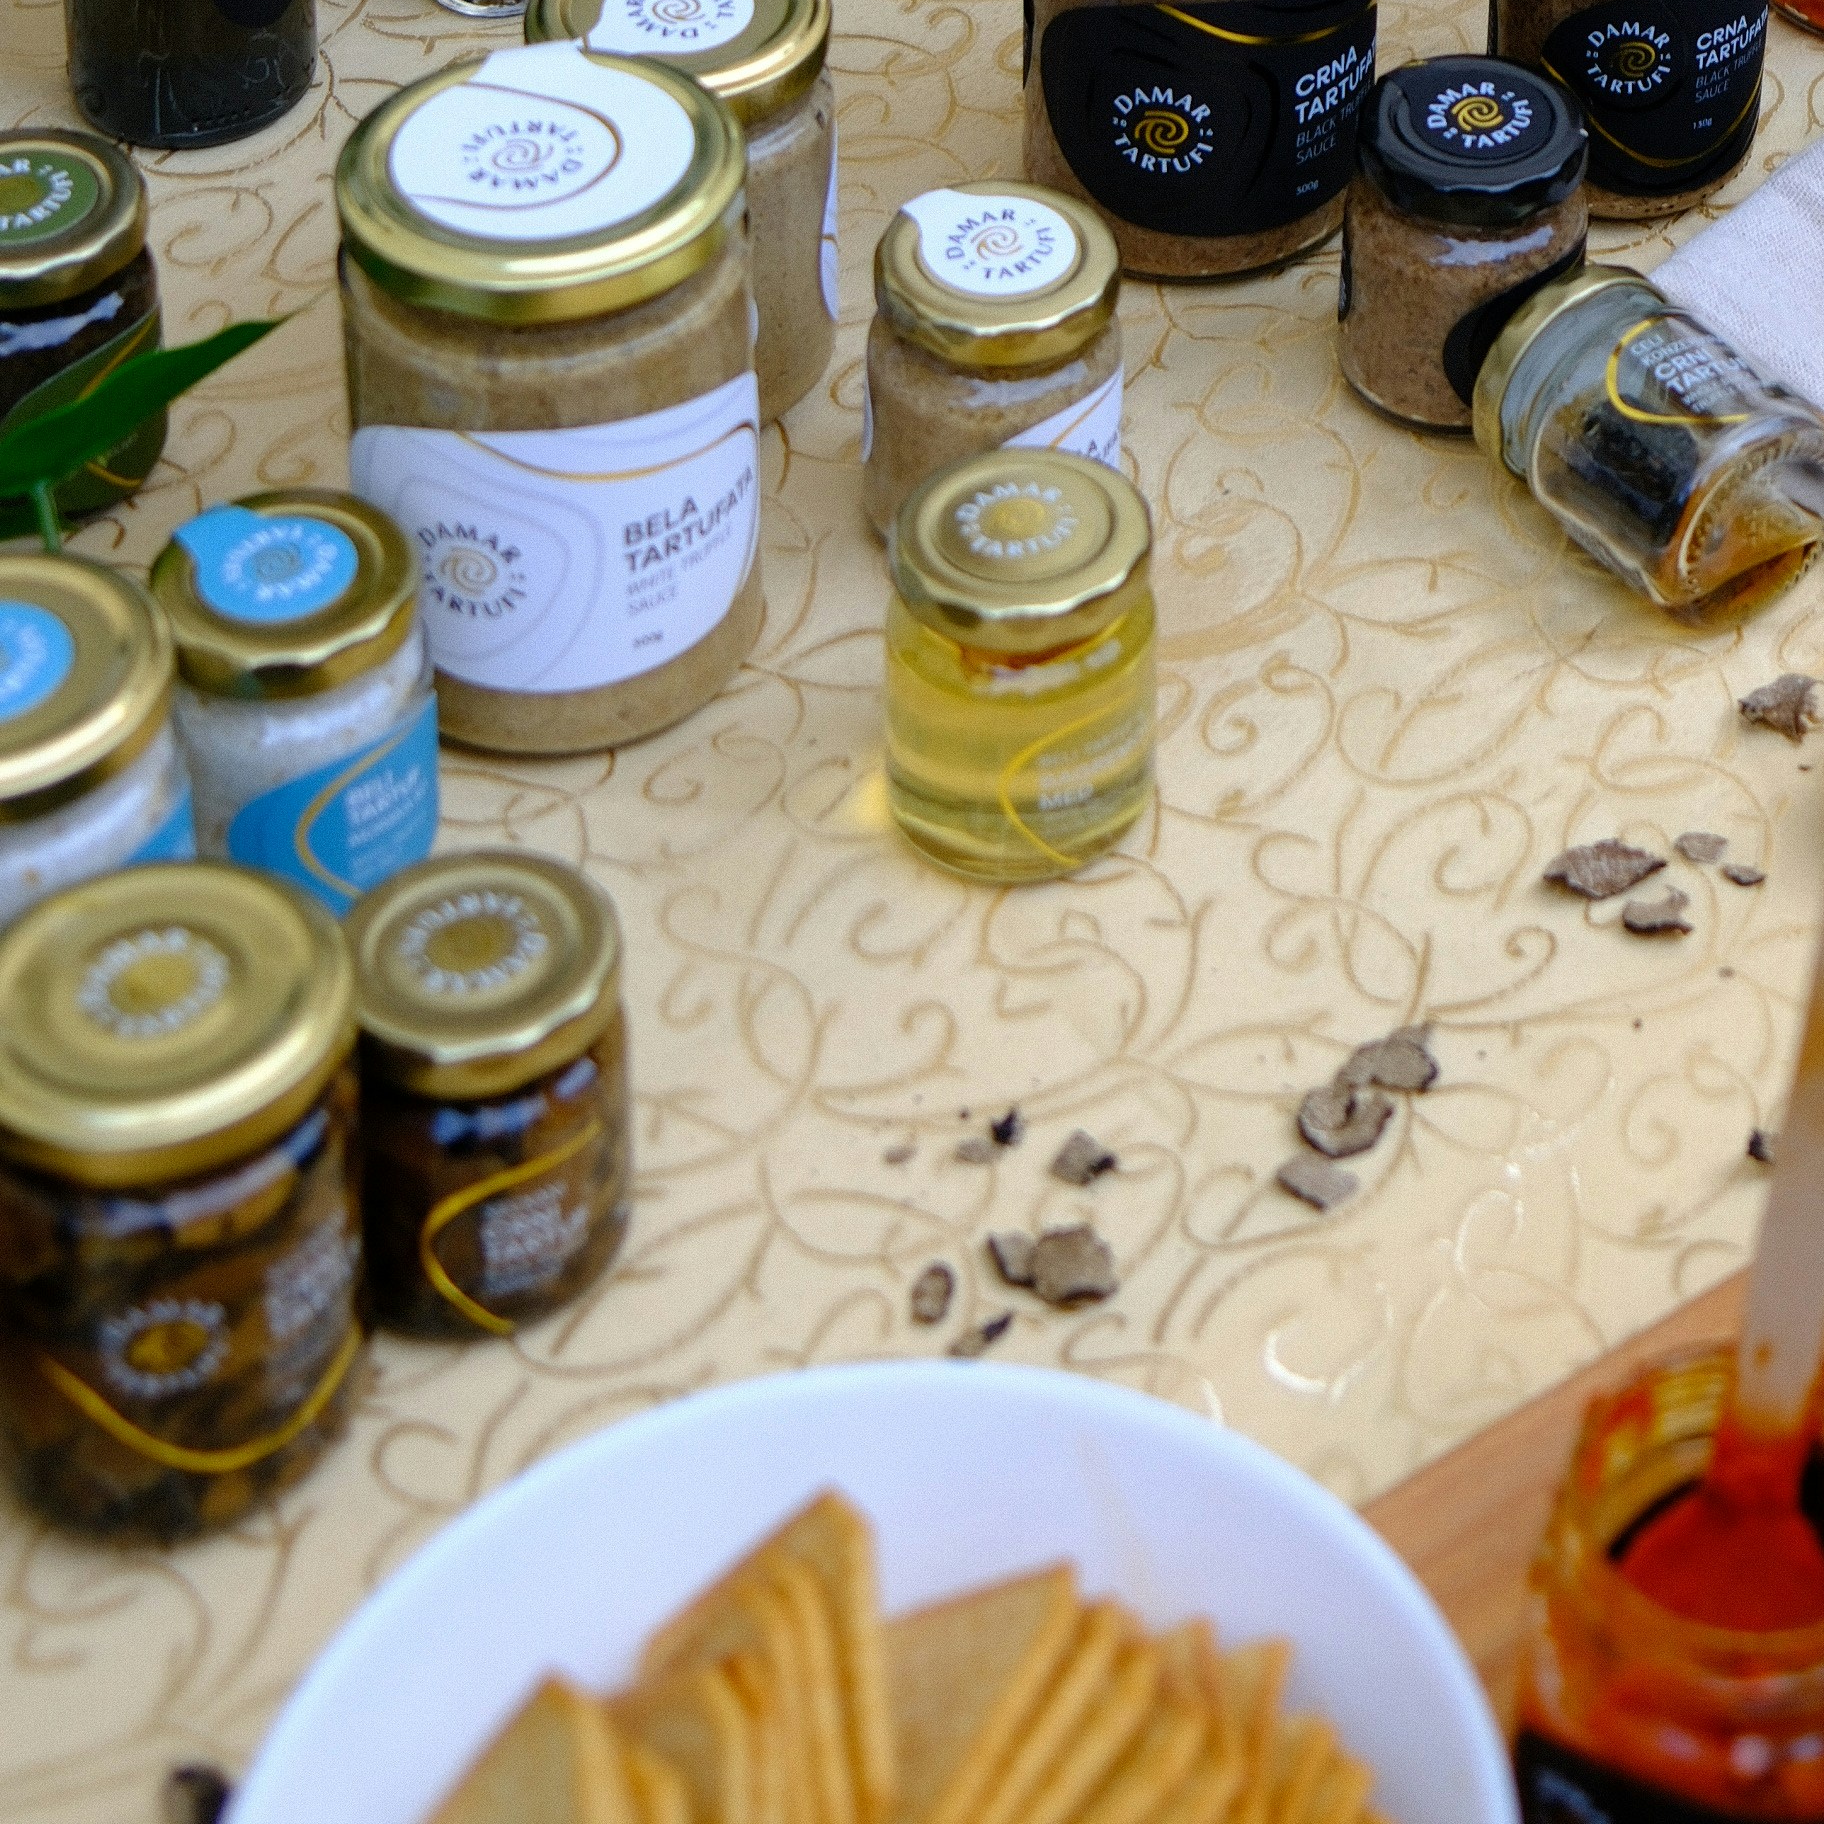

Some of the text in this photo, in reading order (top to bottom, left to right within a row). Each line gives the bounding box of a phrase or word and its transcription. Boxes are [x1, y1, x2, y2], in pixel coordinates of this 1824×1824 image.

[1587, 20, 1671, 49] DAMAR
[1695, 14, 1749, 51] CRNA
[1294, 44, 1359, 99] CRNA
[1587, 62, 1671, 95] TARTUFI
[1694, 65, 1731, 90] BLACK
[1694, 78, 1732, 104] SAUCE
[1113, 85, 1212, 124] DAMAR
[1426, 81, 1496, 130] DAMAR
[1461, 98, 1533, 150] TARTUFI
[1295, 116, 1338, 149] BLACK
[1295, 133, 1338, 166] SAUCE
[1114, 132, 1215, 174] TARTUFI
[945, 207, 1019, 261] DAMAR
[983, 225, 1057, 280] TARTUFI
[416, 519, 523, 565] DAMAR
[622, 494, 702, 550] BELA
